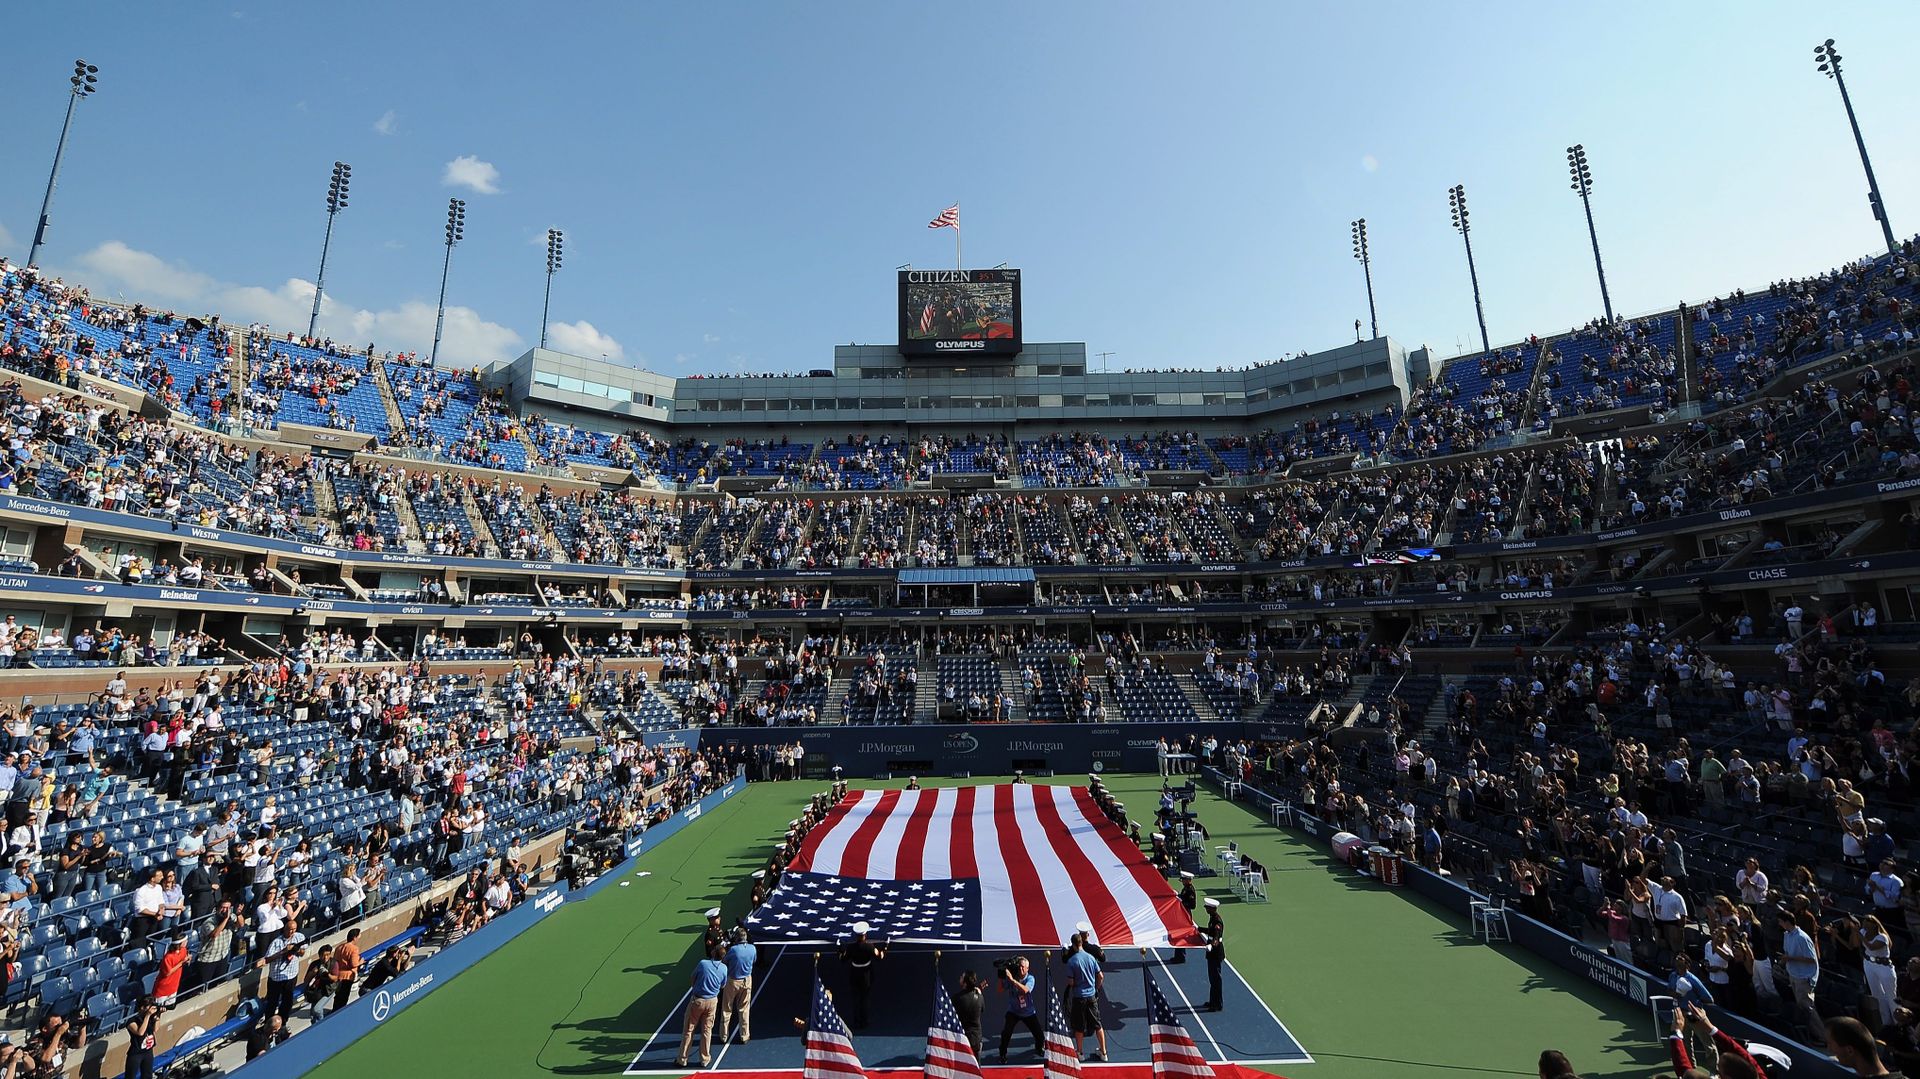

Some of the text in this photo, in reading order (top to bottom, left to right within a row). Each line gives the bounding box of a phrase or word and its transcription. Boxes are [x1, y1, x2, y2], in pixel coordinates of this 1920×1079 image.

[908, 271, 970, 282] CITIZEN
[8, 499, 70, 516] Mercedes-Benz
[1720, 509, 1750, 520] Wilson
[1614, 528, 1638, 538] CHANNEL
[1502, 540, 1536, 550] Heineken
[302, 546, 336, 557] OLYMPUS
[1748, 568, 1788, 580] CHASE
[160, 589, 198, 600] Heineken
[1500, 591, 1552, 600] OLYMPUS
[306, 600, 334, 610] CITIZEN
[534, 889, 558, 910] American
[544, 894, 564, 913] Express
[1570, 945, 1626, 981] Continental
[1588, 967, 1627, 995] Airlines
[392, 973, 433, 1005] Mercedes-Benz
